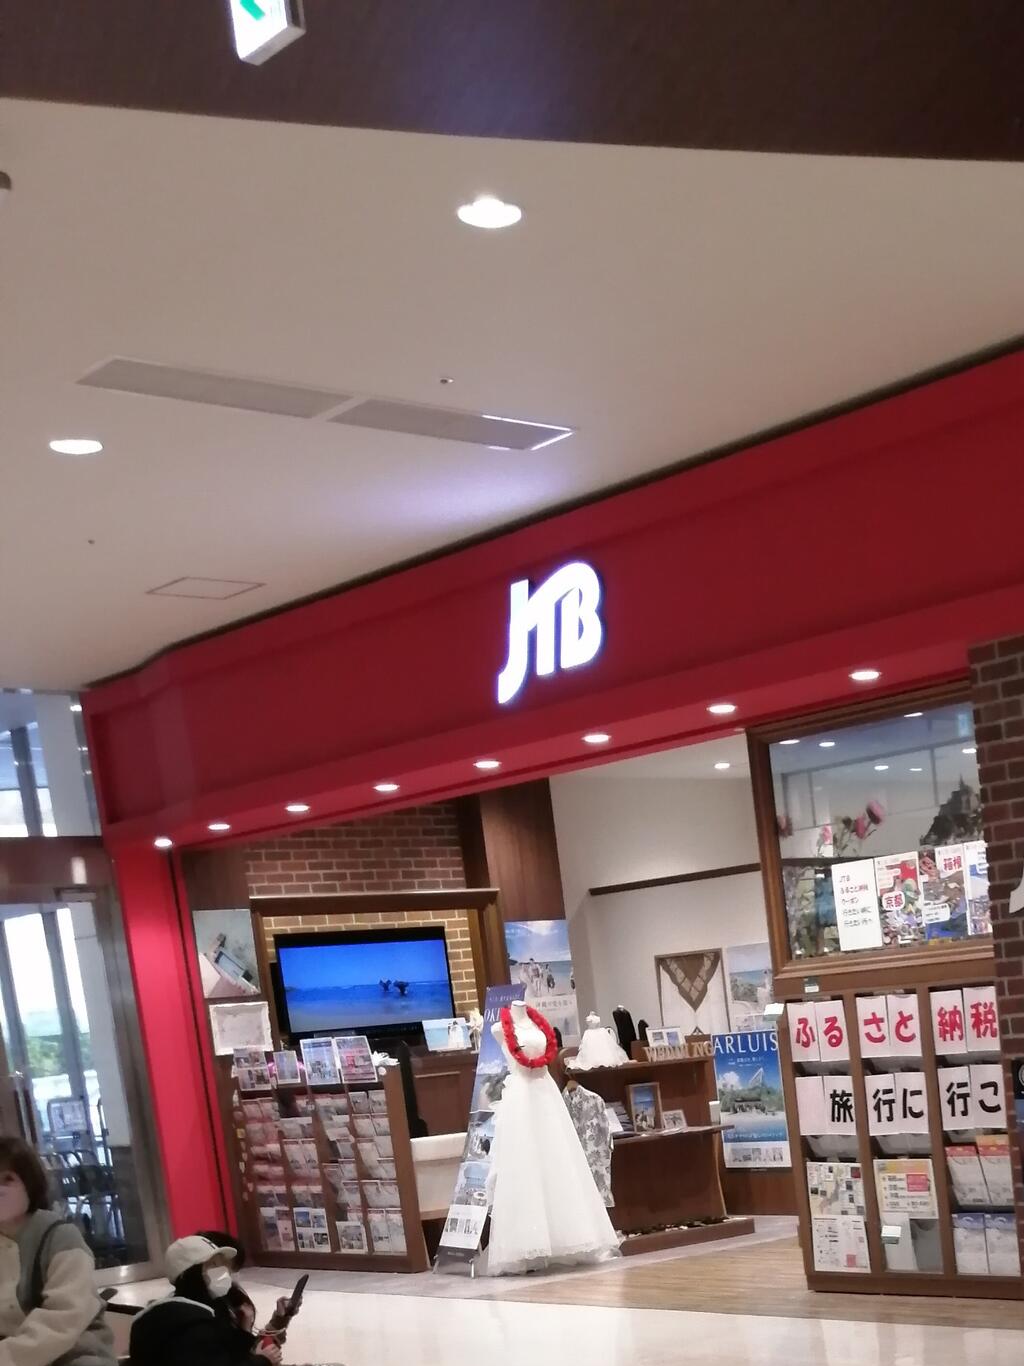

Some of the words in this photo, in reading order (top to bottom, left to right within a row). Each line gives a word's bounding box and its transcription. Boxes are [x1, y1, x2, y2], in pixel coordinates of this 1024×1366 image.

[498, 562, 602, 704] JTB
[714, 1032, 779, 1055] ARLUIS
[795, 1001, 998, 1049] ふるさと納税
[829, 1081, 1002, 1123] 旅行に行こ
